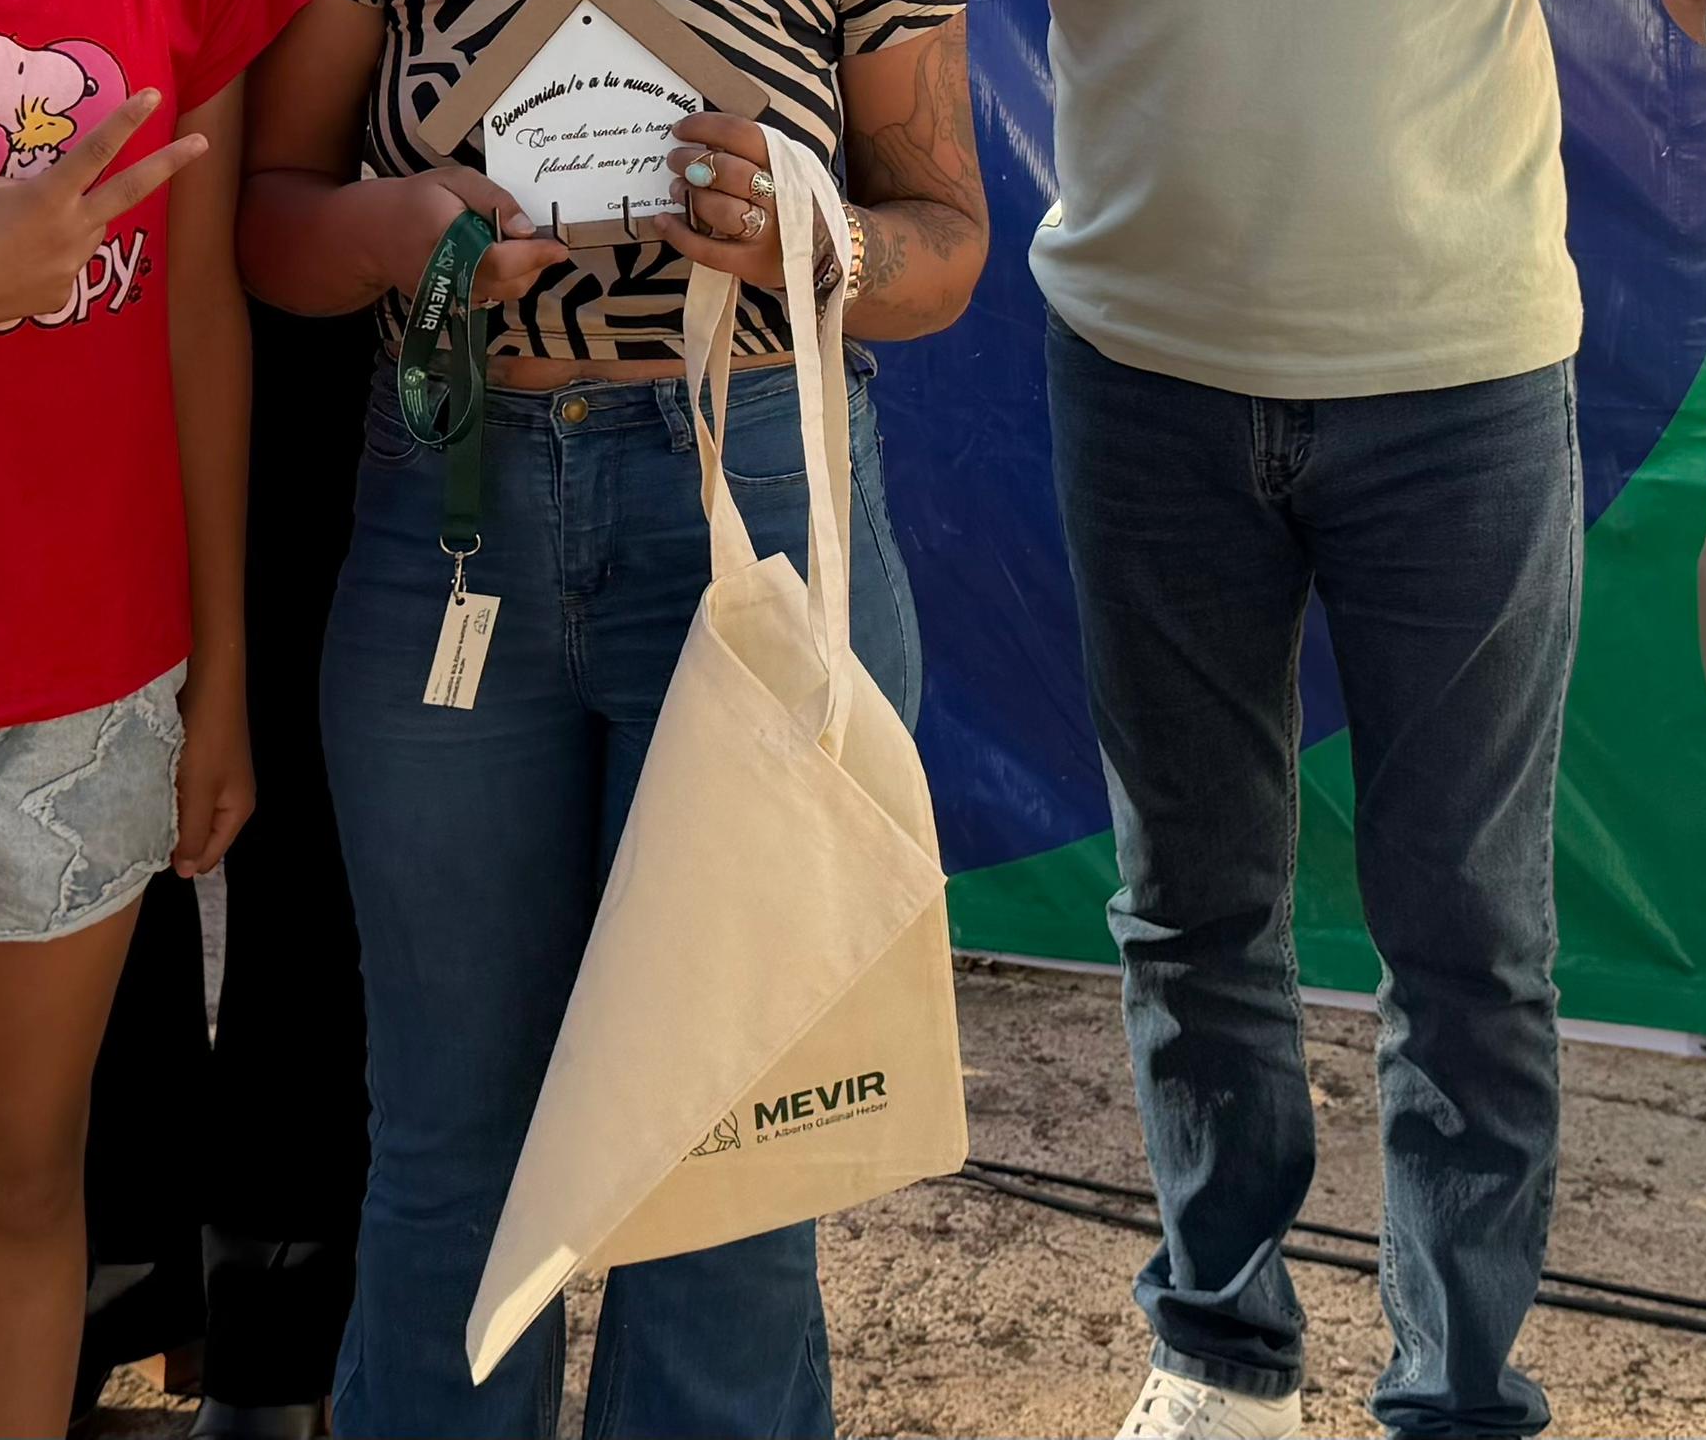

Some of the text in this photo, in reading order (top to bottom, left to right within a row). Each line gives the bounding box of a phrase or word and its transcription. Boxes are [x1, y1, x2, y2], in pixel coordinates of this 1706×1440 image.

[491, 71, 696, 136] Bienvenida/o a tu nuevo nido
[516, 127, 558, 148] Que
[561, 123, 589, 141] cada
[645, 121, 672, 140] traig
[597, 158, 627, 168] amor
[626, 157, 640, 174] y
[421, 275, 452, 331] MEVIR
[753, 1070, 887, 1131] MEVIR
[756, 1133, 771, 1144] Dr.
[774, 1122, 814, 1139] Alberto
[855, 1101, 889, 1116] Heber
